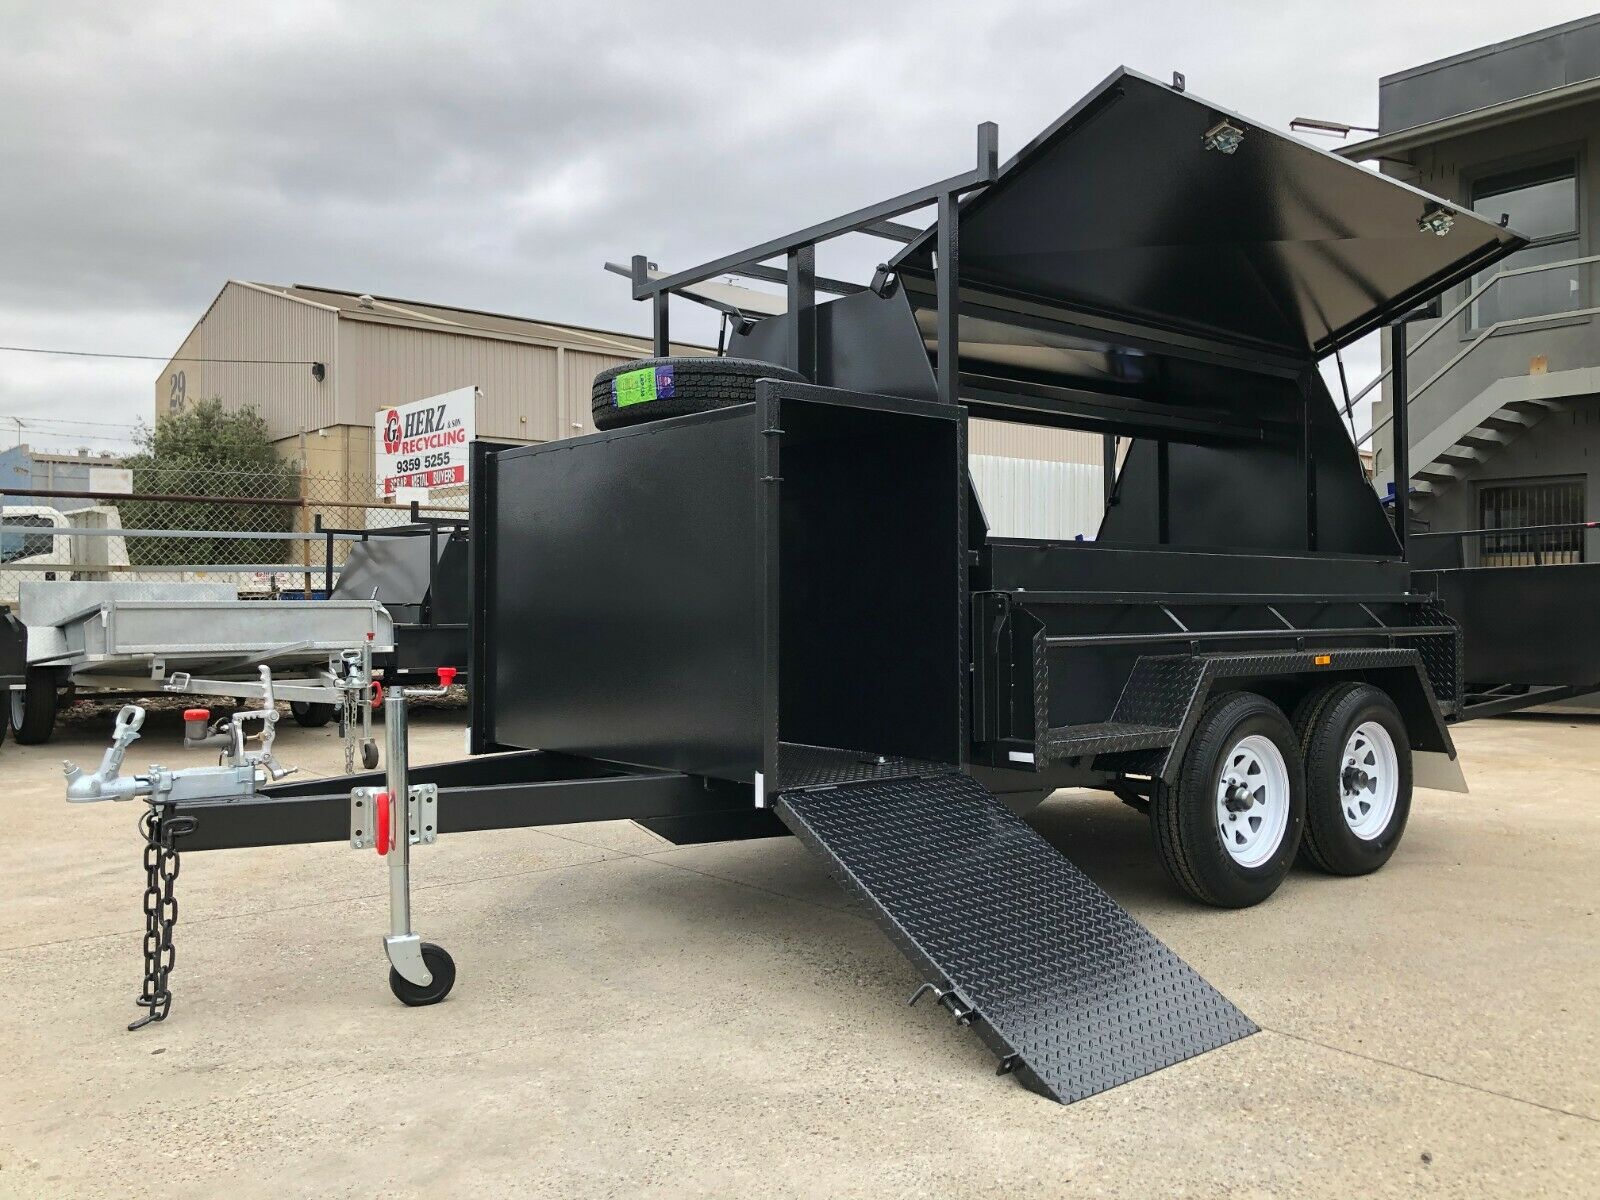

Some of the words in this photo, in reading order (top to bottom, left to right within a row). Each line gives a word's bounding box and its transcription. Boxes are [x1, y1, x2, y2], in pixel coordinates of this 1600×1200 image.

[170, 370, 186, 408] 29
[404, 404, 447, 439] HERZ
[451, 418, 461, 428] SON
[402, 428, 465, 454] RECYCLING
[396, 457, 421, 474] 9359
[424, 452, 450, 468] 5255
[411, 473, 429, 487] METAL
[433, 469, 455, 484] BUYERS
